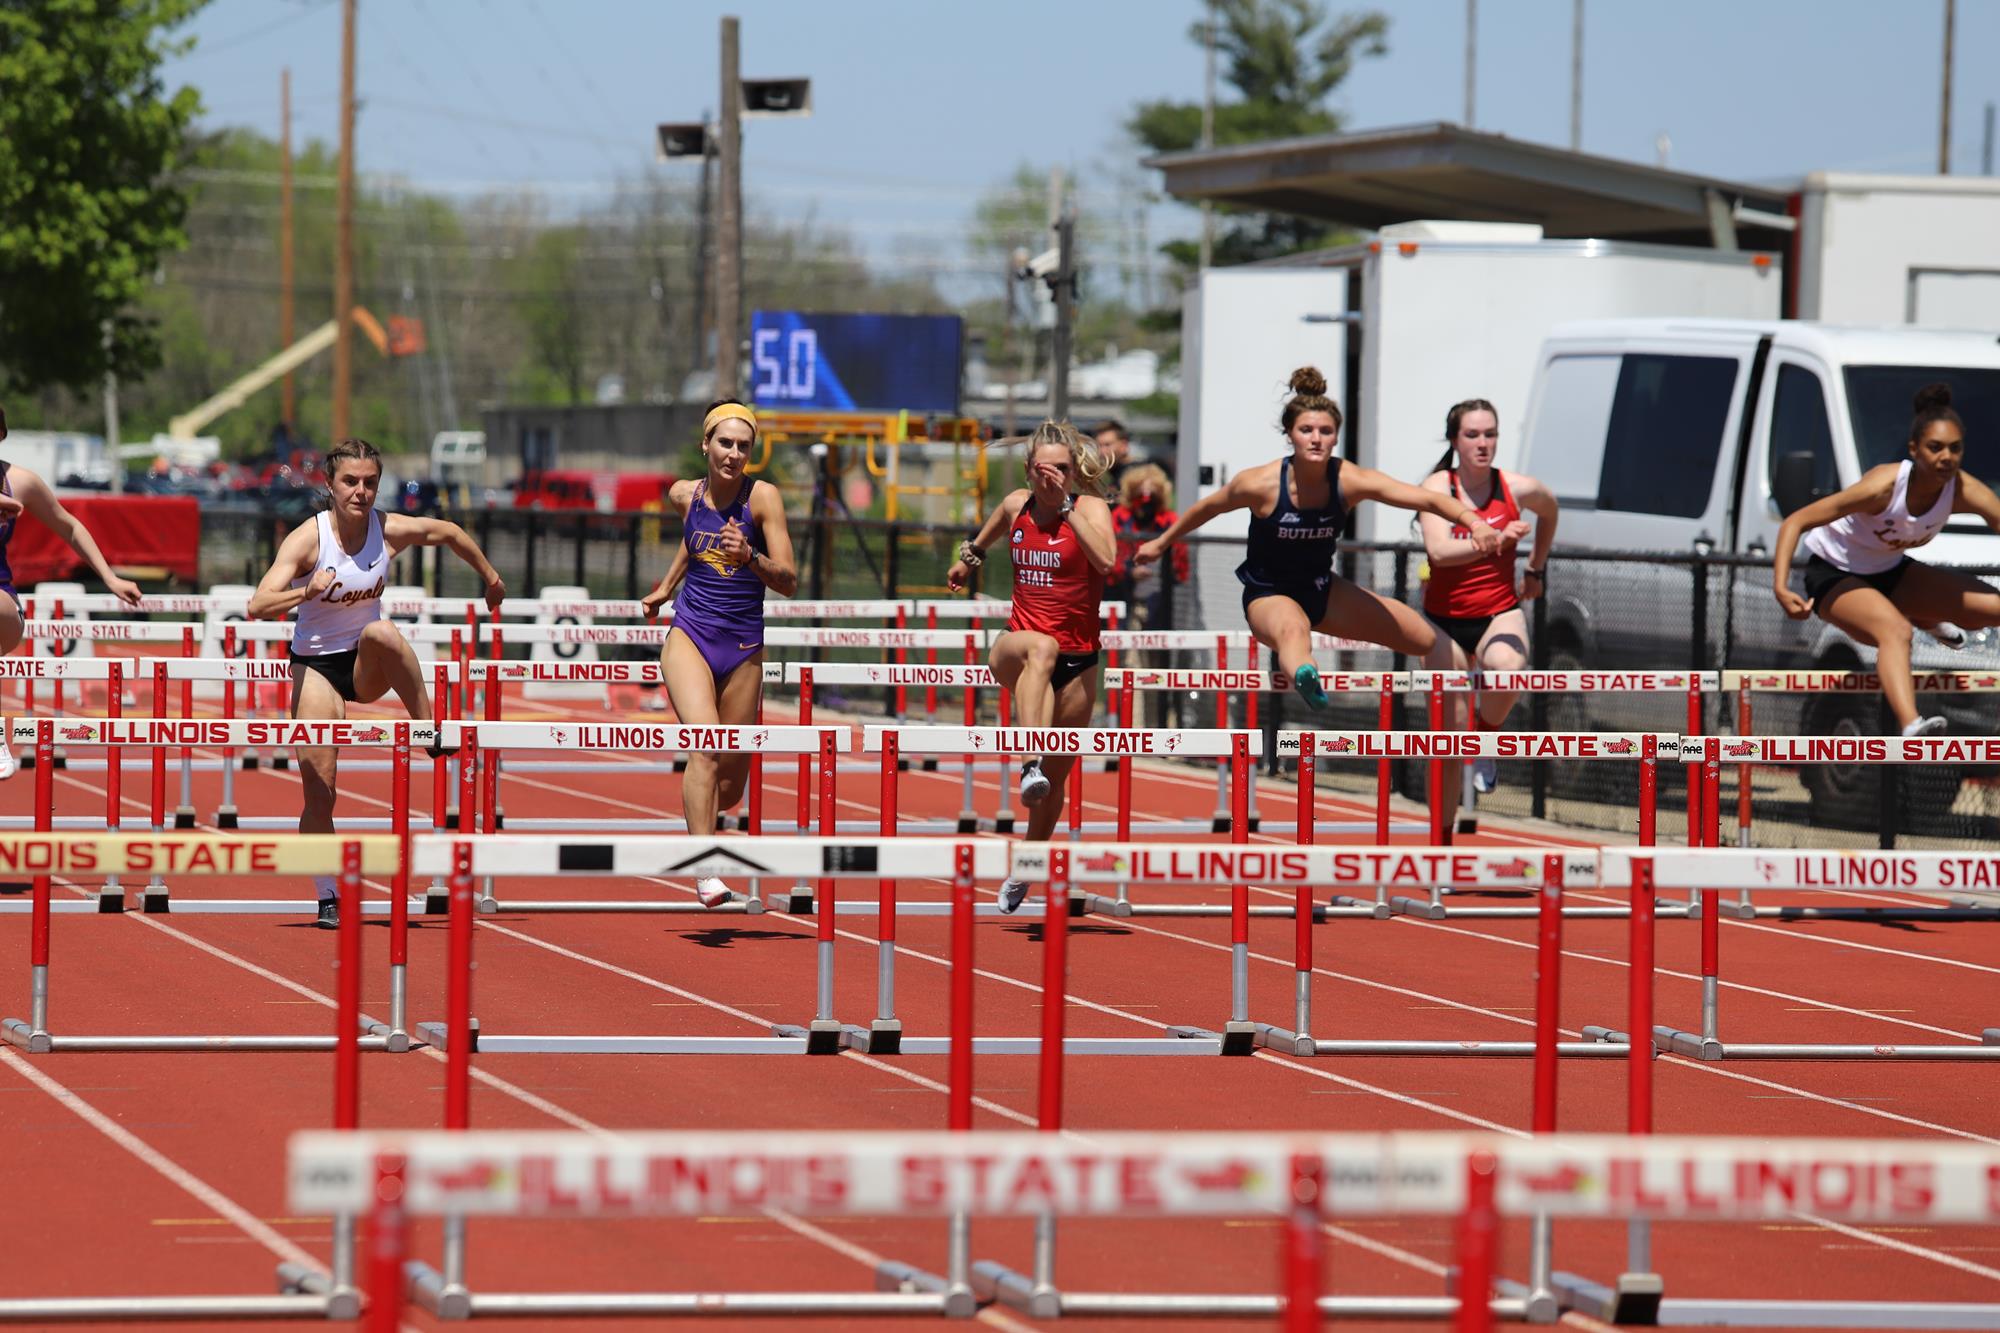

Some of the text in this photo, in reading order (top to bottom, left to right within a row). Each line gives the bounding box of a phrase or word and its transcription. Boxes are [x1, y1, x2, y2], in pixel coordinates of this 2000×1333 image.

[754, 328, 816, 398] 5.0
[1278, 527, 1334, 539] BUTLER
[1012, 548, 1060, 568] ILLINOIS
[1020, 570, 1053, 587] STATE
[27, 624, 131, 640] ILLINOIS STATE
[564, 628, 664, 643] ILLINOIS STATE
[817, 631, 916, 645] ILLINOIS STATE
[1131, 635, 1168, 648] STATE
[0, 660, 45, 677] STATE
[533, 663, 630, 681] ILLINOIS
[889, 668, 998, 684] ILLINOIS STA
[1167, 672, 1261, 689] ILLINOIS
[1273, 674, 1349, 690] STE
[1474, 674, 1656, 690] ILLINOIS STATE
[1786, 674, 1970, 691] ILLINOIS TATE
[100, 722, 230, 744] ILLINOIS
[247, 723, 352, 744] STATE
[578, 727, 740, 749] ILLINOIS STATE
[995, 731, 1154, 752] ILLINOIS STATE
[1357, 734, 1481, 756] ILLINOIS
[1497, 735, 1598, 757] STATE
[1761, 739, 1887, 761] ILLINOIS
[1903, 740, 2000, 761] STATE
[126, 842, 277, 872] STATE
[1131, 851, 1478, 883] ILLINOIS STATE
[1796, 857, 2000, 887] ILLINOIS STAT
[517, 1152, 1166, 1211] ILLINOIS STATE
[1606, 1156, 1937, 1215] ILLINOIS
